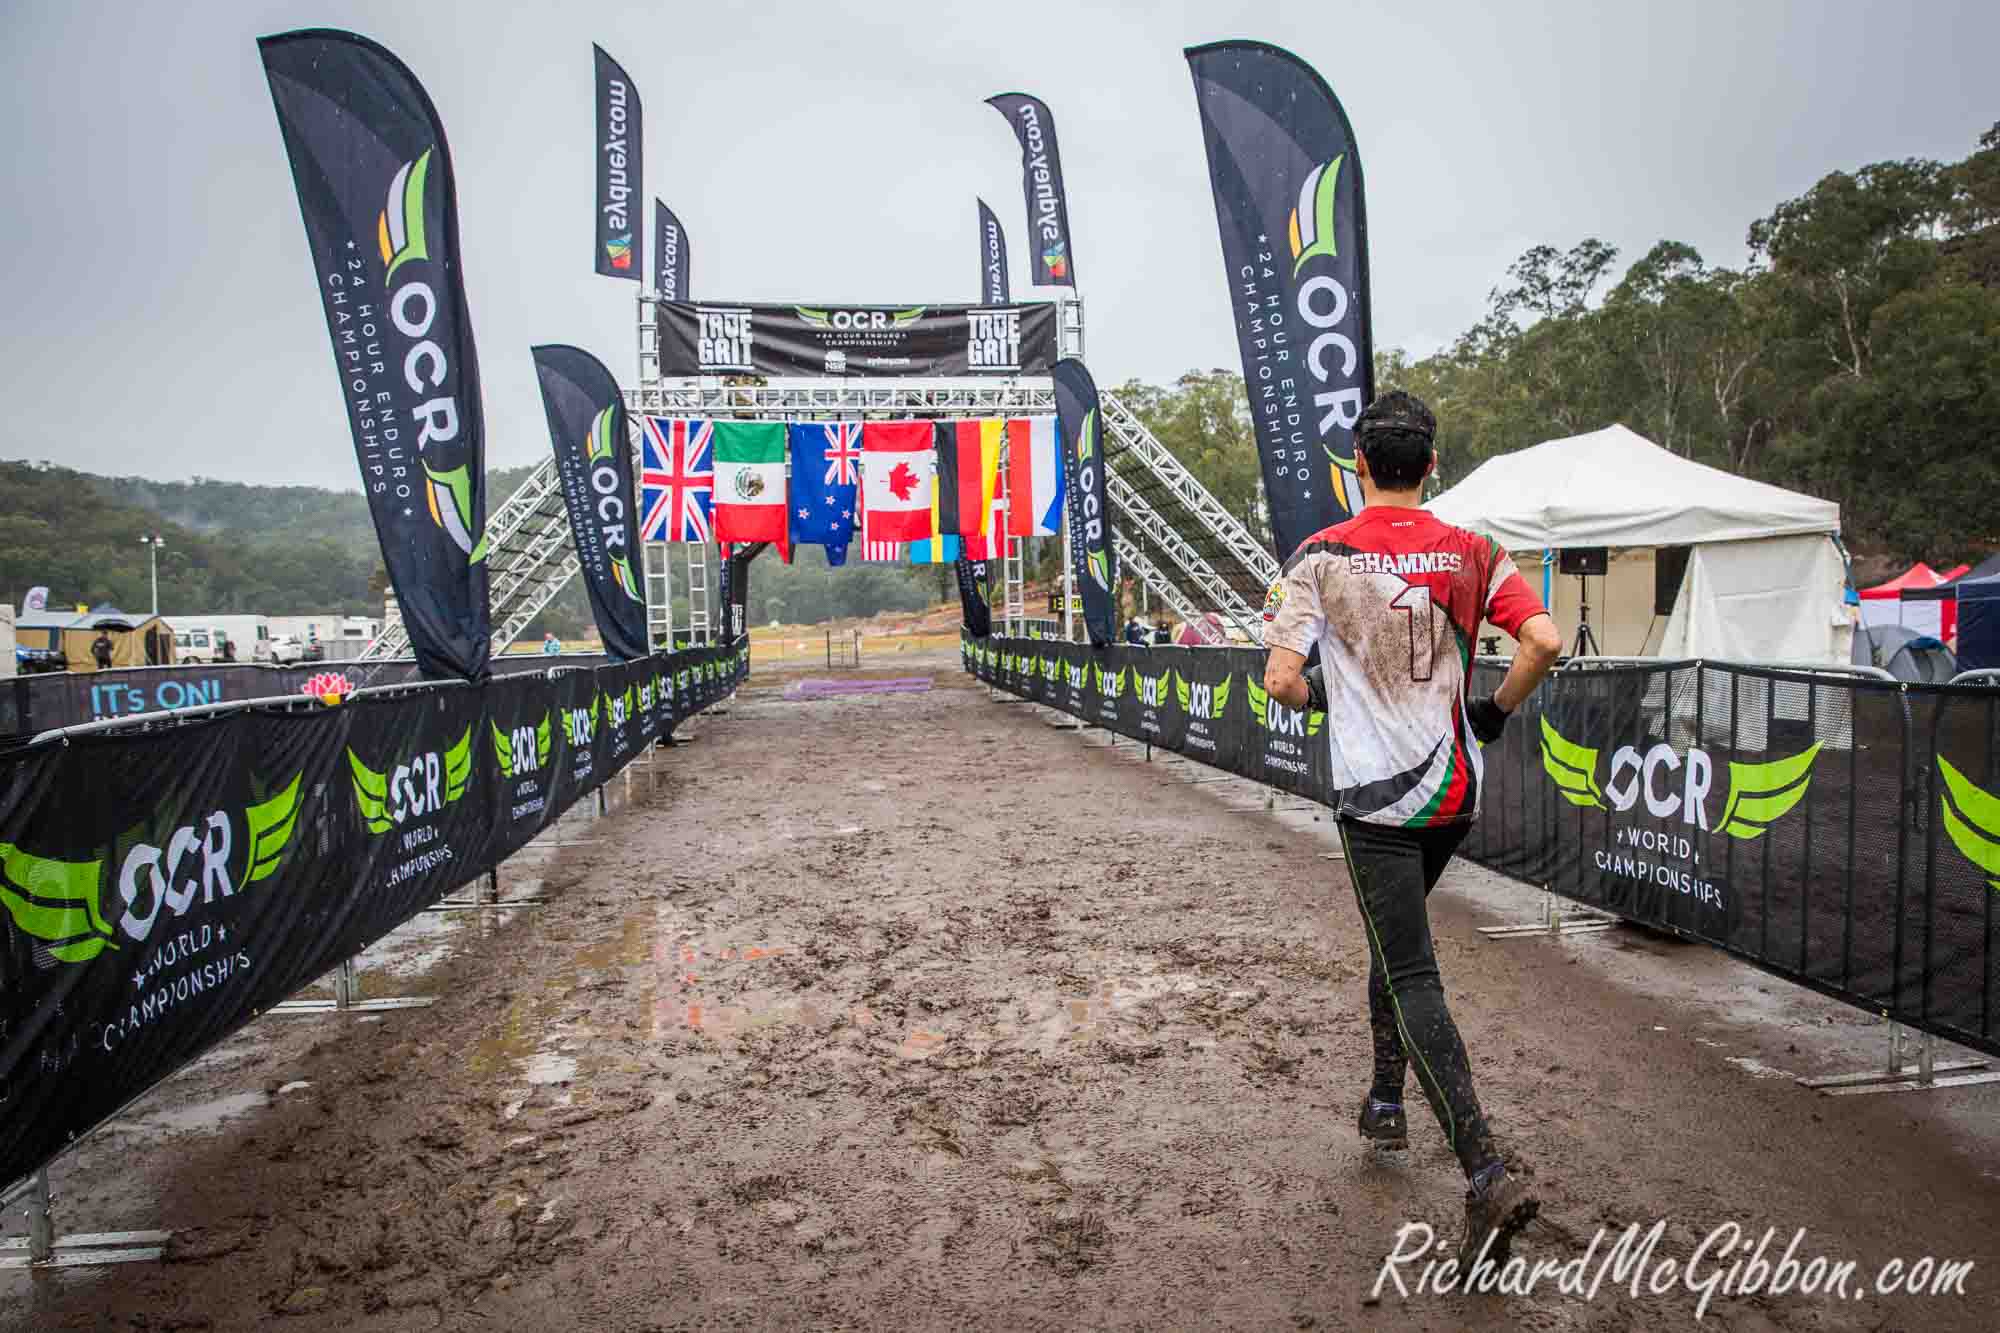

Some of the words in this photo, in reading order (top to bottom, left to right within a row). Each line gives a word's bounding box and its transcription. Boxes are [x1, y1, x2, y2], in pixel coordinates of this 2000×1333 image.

[1260, 252, 1275, 280] 24
[696, 312, 752, 338] TRUE
[698, 337, 752, 365] GRIT
[832, 311, 888, 330] OCR
[966, 313, 1020, 339] TRUE
[967, 338, 1020, 365] GRIT
[1265, 294, 1289, 362] HOUR
[327, 272, 388, 494] CHAMPIONSHIPS
[348, 258, 366, 287] 24
[358, 303, 385, 376] HOUR
[376, 390, 411, 499] ENDURO
[390, 281, 459, 452] OCR
[1241, 264, 1288, 478] CHAMPIONSHIPS
[1297, 275, 1362, 437] OCR
[1281, 378, 1310, 482] ENDURO
[577, 476, 591, 512] HOUR
[591, 466, 625, 550] OCR
[1080, 466, 1103, 544] OCR
[1349, 551, 1462, 575] SHAMMES
[1390, 583, 1434, 682] 1
[90, 681, 145, 714] IT's
[156, 678, 221, 710] ON!
[1188, 680, 1211, 720] OCR
[511, 725, 538, 776] OCR
[390, 751, 441, 825] OCR
[1604, 743, 1713, 832] OCR
[118, 810, 234, 942] OCR
[1627, 826, 1690, 860] WORLD
